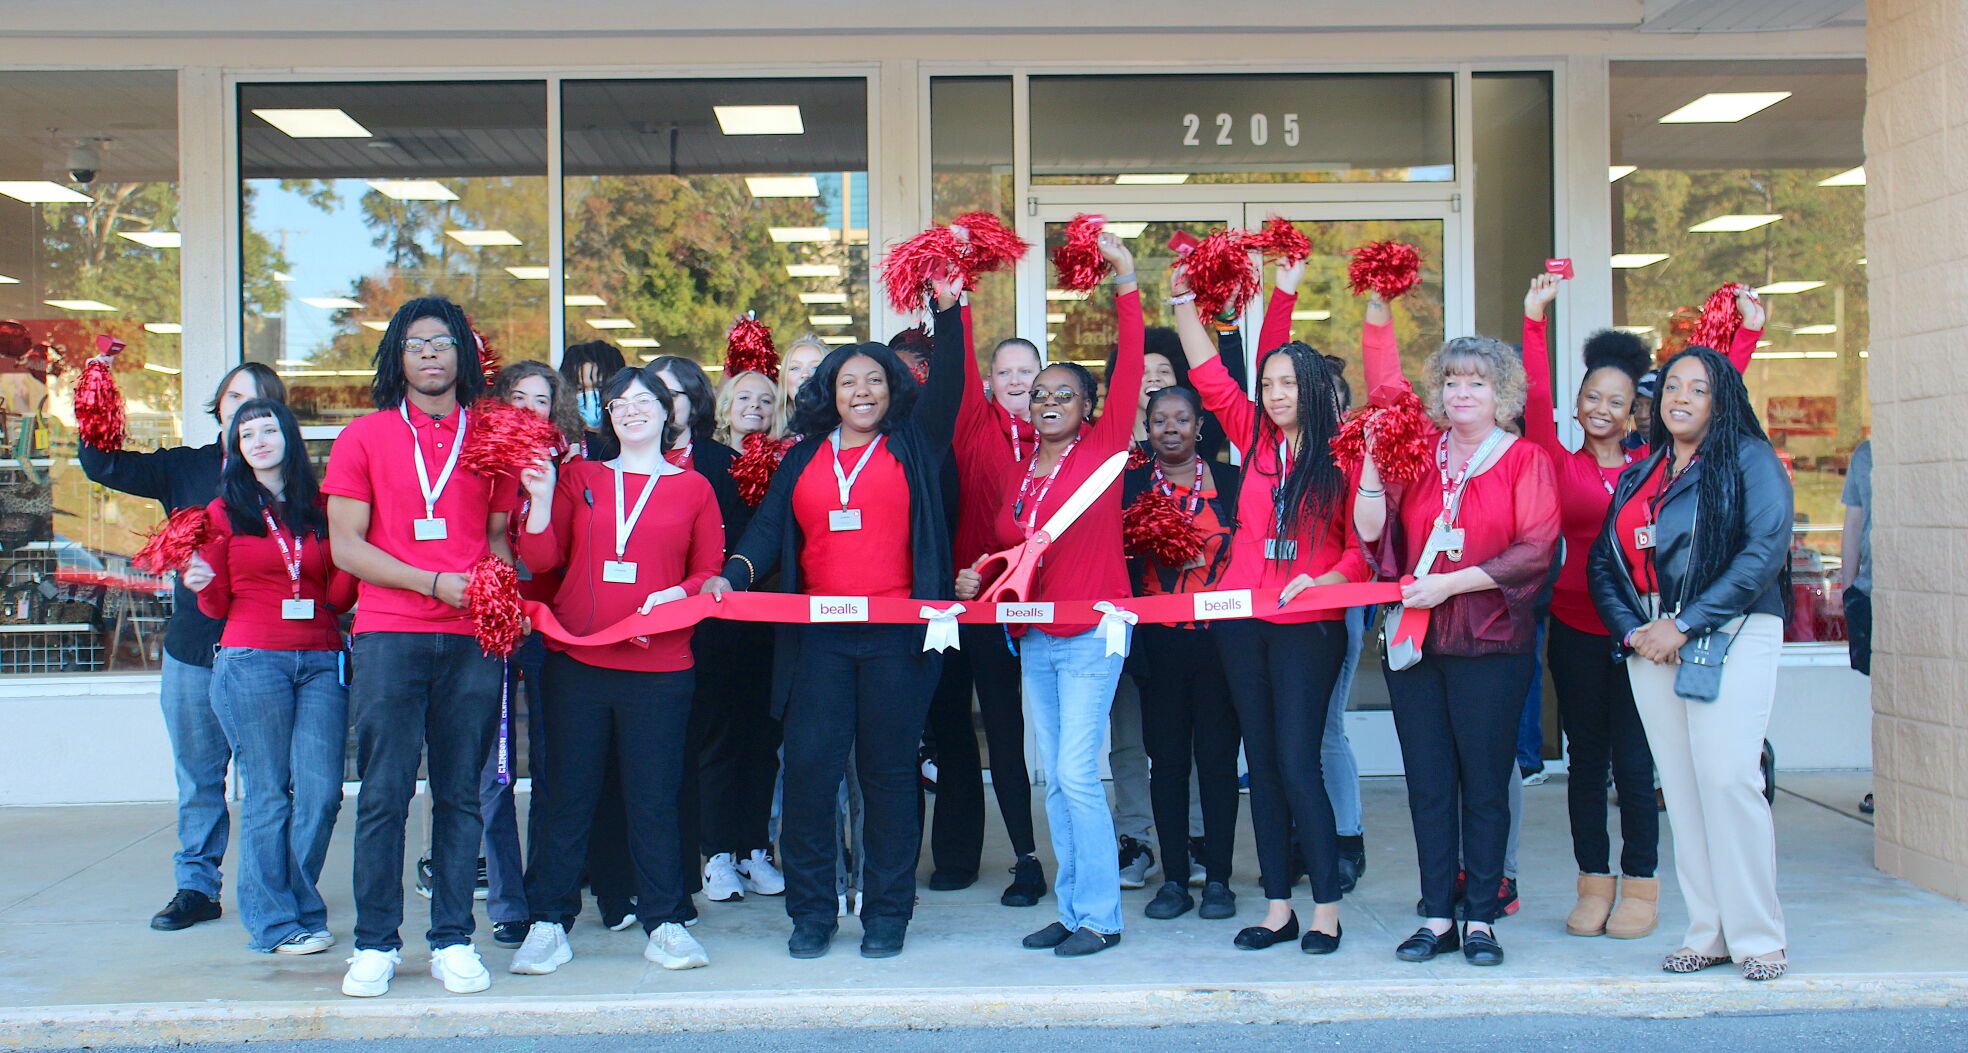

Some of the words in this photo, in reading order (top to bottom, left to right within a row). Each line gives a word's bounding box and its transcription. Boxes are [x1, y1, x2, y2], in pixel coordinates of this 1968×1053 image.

[1183, 113, 1299, 147] 2205
[820, 602, 858, 615] bealls
[1204, 598, 1242, 612] bealls
[1006, 607, 1044, 618] bealls
[498, 737, 507, 774] CLEMSON
